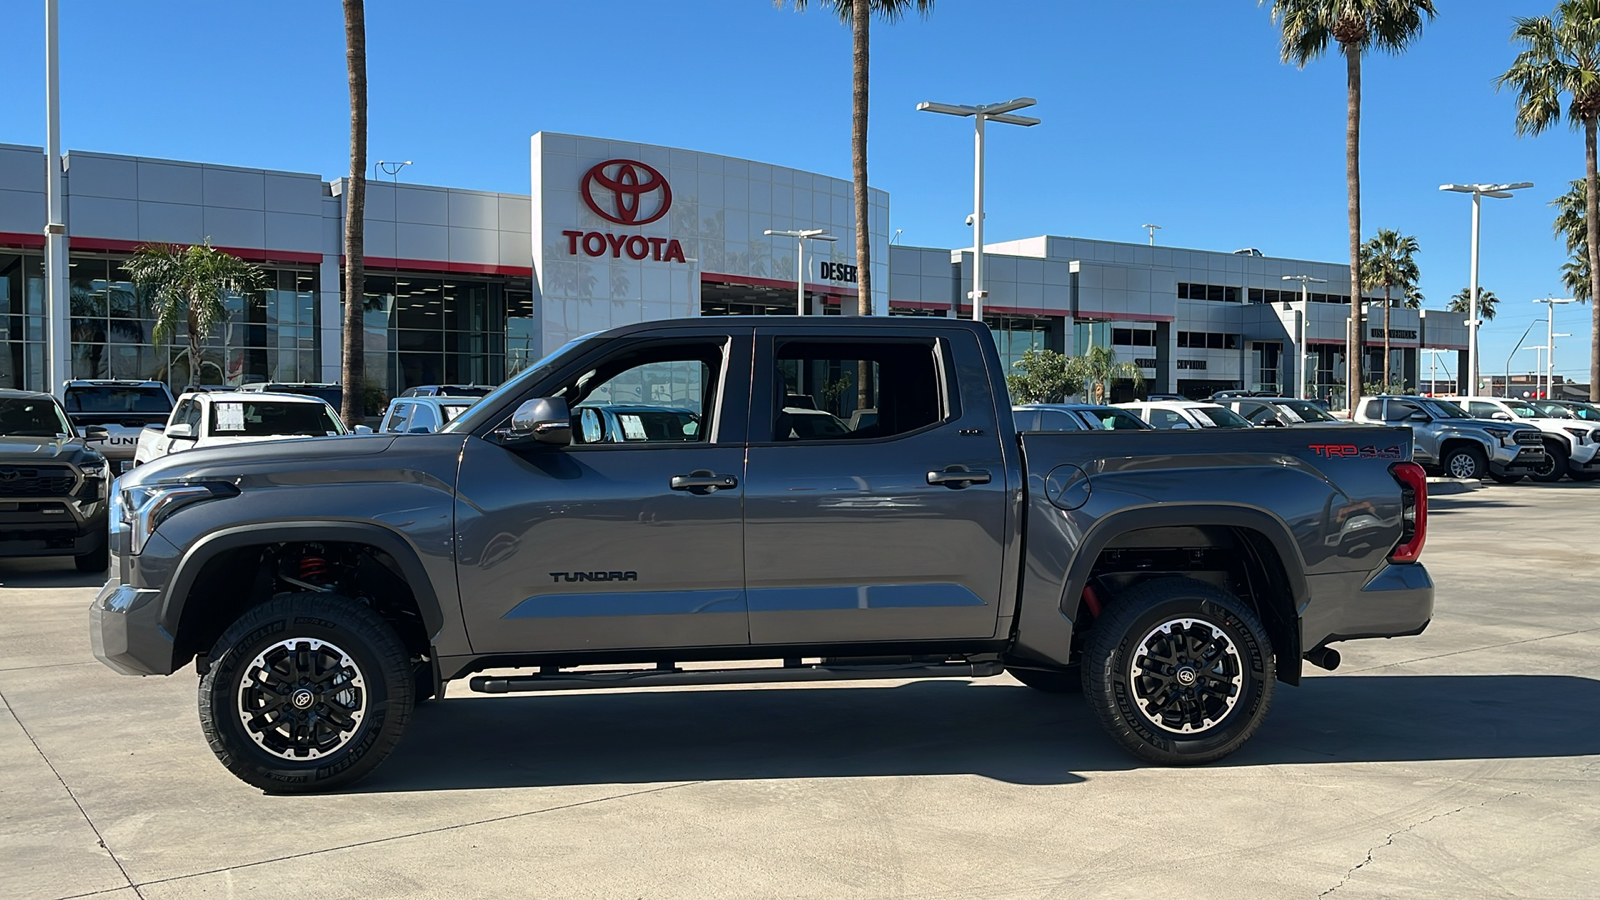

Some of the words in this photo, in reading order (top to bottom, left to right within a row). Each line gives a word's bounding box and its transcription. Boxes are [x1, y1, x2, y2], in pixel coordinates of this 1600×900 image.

[562, 230, 686, 263] TOYOTA
[821, 261, 857, 282] DESER
[1134, 358, 1156, 368] SERV
[1309, 444, 1358, 458] TRD
[549, 571, 637, 582] TUNDRA
[225, 620, 284, 670] MICHELIN
[1226, 614, 1262, 671] MICHELIN
[1115, 683, 1152, 739] MICHELIN
[319, 731, 376, 778] MICHELIN
